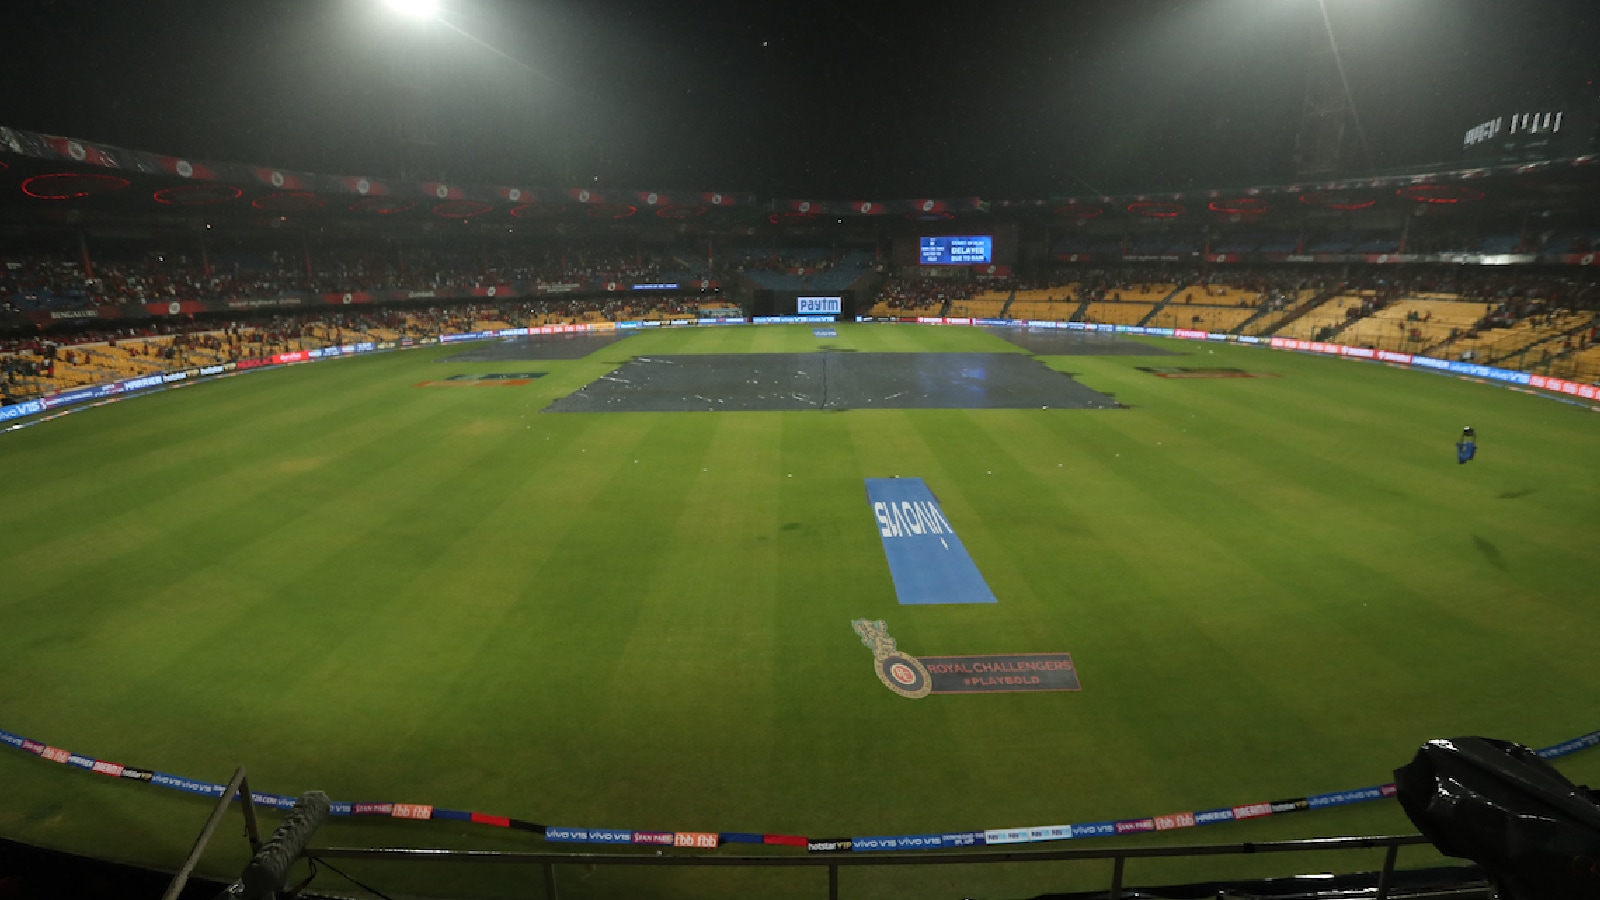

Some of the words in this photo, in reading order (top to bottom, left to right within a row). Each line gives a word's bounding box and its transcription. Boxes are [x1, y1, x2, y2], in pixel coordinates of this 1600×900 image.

[927, 662, 972, 674] ROYAL
[975, 660, 1072, 673] CHALLENGERS
[965, 676, 1040, 685] #PLAYBOLD
[547, 829, 568, 838] vivo
[589, 831, 613, 840] vivo
[676, 834, 694, 844] fbb
[697, 835, 716, 846] fbb
[854, 840, 878, 848] vivo
[898, 837, 923, 845] vivo
